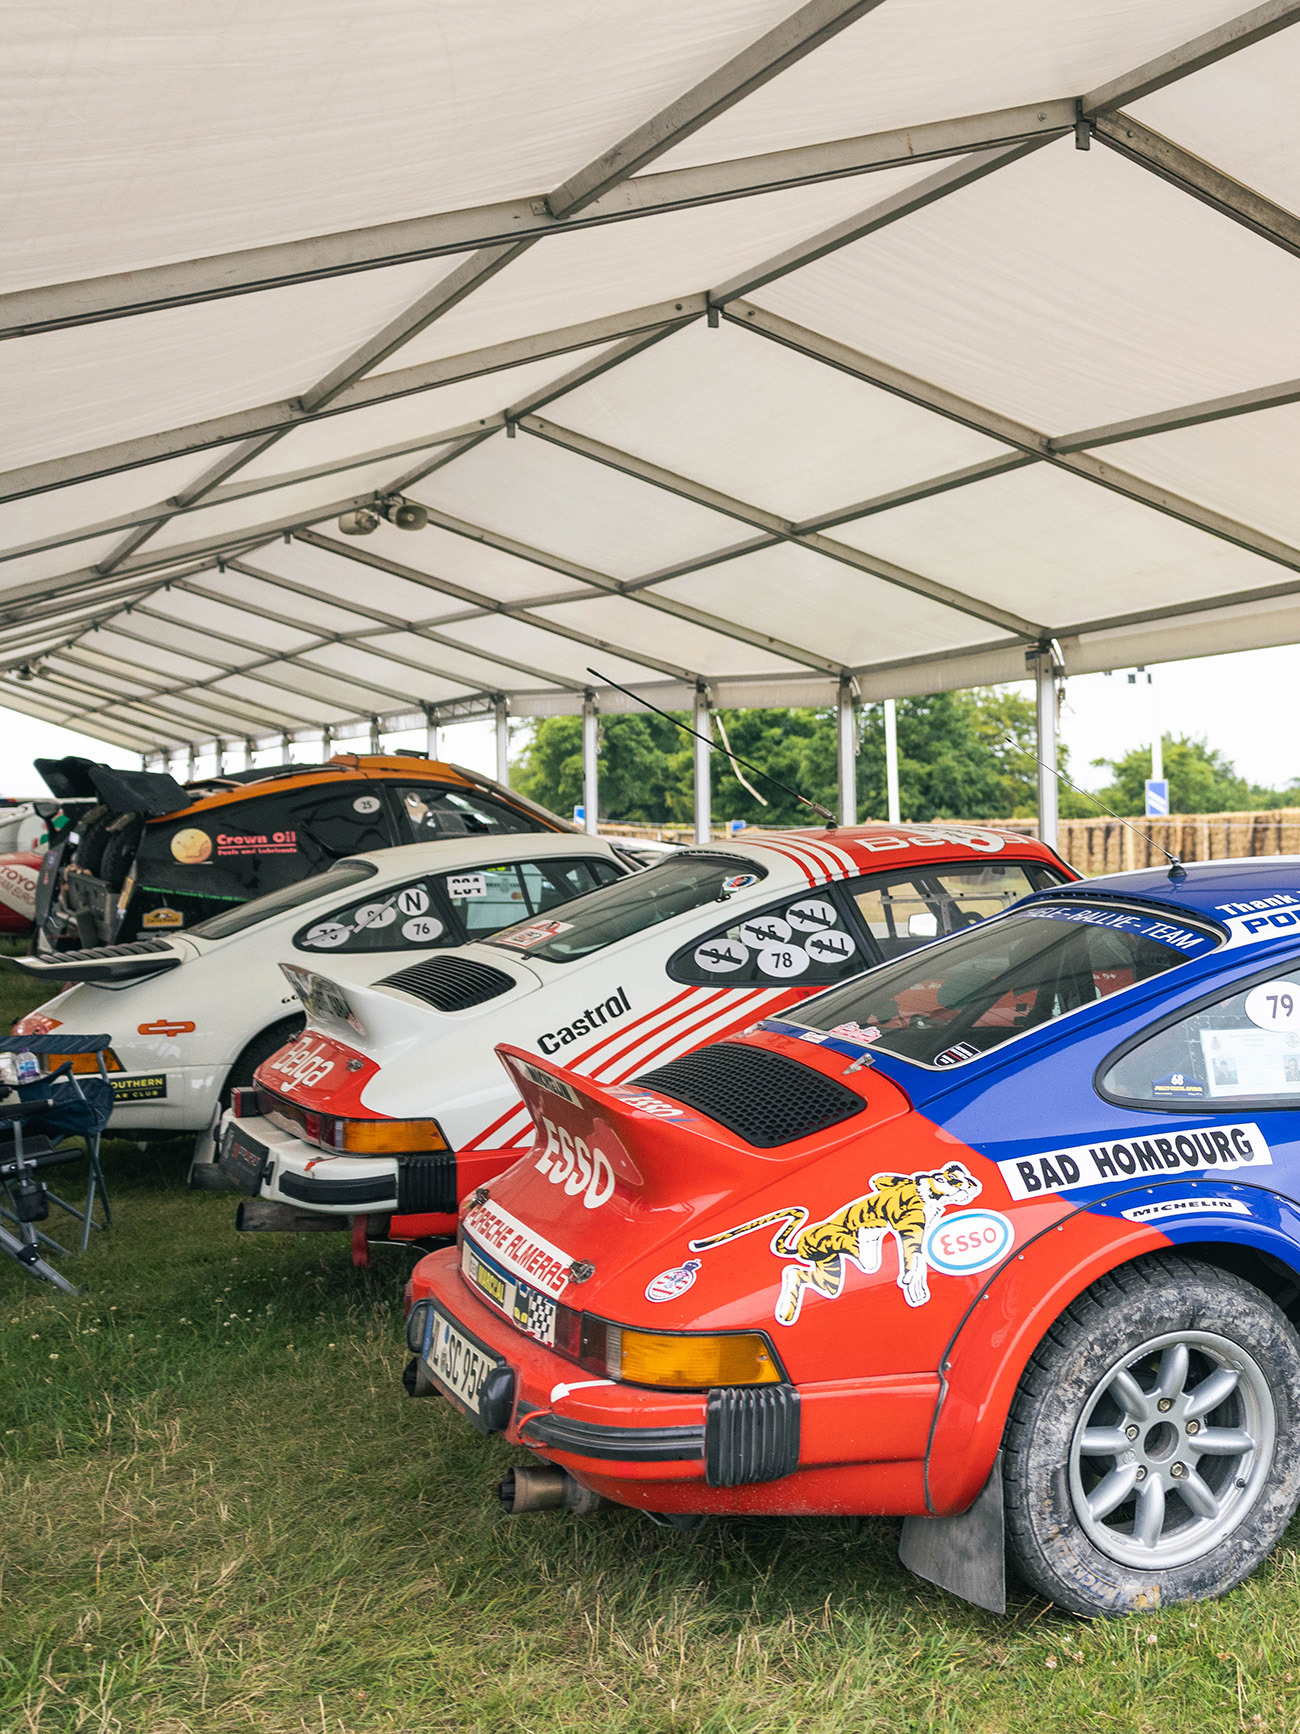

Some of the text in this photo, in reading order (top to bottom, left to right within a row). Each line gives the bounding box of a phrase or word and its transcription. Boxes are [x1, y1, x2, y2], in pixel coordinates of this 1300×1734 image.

[217, 831, 297, 845] Crown Oil
[1, 866, 36, 892] TOYO
[405, 892, 422, 911] N
[1214, 893, 1300, 916] Thank
[413, 922, 430, 936] 76
[1140, 922, 1205, 950] TEAM
[771, 952, 793, 968] 78
[1266, 993, 1294, 1019] 79
[537, 986, 632, 1055] Castrol
[271, 1036, 335, 1093] Belga
[110, 1077, 163, 1089] OUTHERN
[1171, 1074, 1184, 1085] 68
[132, 1090, 158, 1098] CLUB
[618, 1096, 684, 1117] ESSO
[534, 1116, 615, 1209] ESSO
[1016, 1128, 1255, 1193] BAD HOMBOURG
[1132, 1200, 1234, 1217] MICHELIN
[468, 1207, 572, 1292] PORSCHE ALMERAS
[940, 1227, 997, 1256] Esso
[445, 1334, 462, 1385] SC
